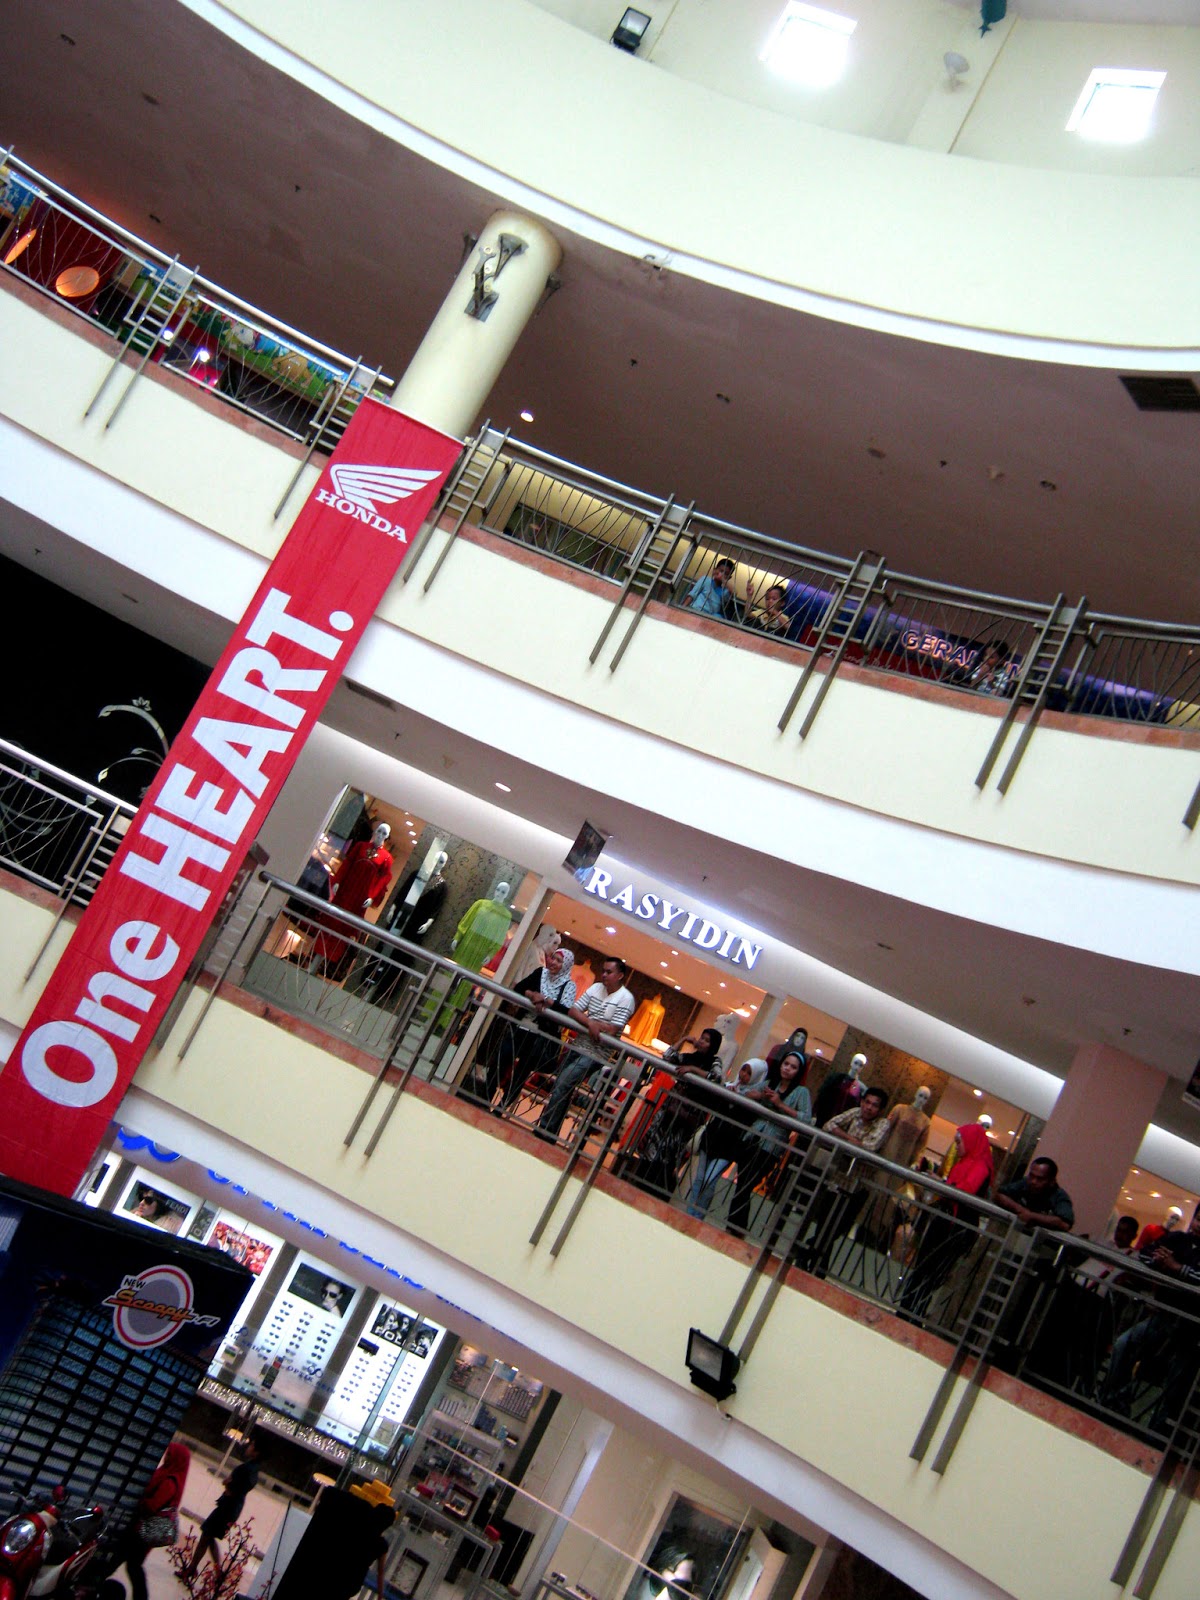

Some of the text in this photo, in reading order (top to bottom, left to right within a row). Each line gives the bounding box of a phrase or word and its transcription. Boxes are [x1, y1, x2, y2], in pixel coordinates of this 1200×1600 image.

[315, 488, 408, 544] HONDA
[21, 586, 354, 1109] One HEART.
[584, 866, 764, 970] RASYIDIN
[165, 1199, 189, 1215] FENDI
[123, 1278, 146, 1289] NEW
